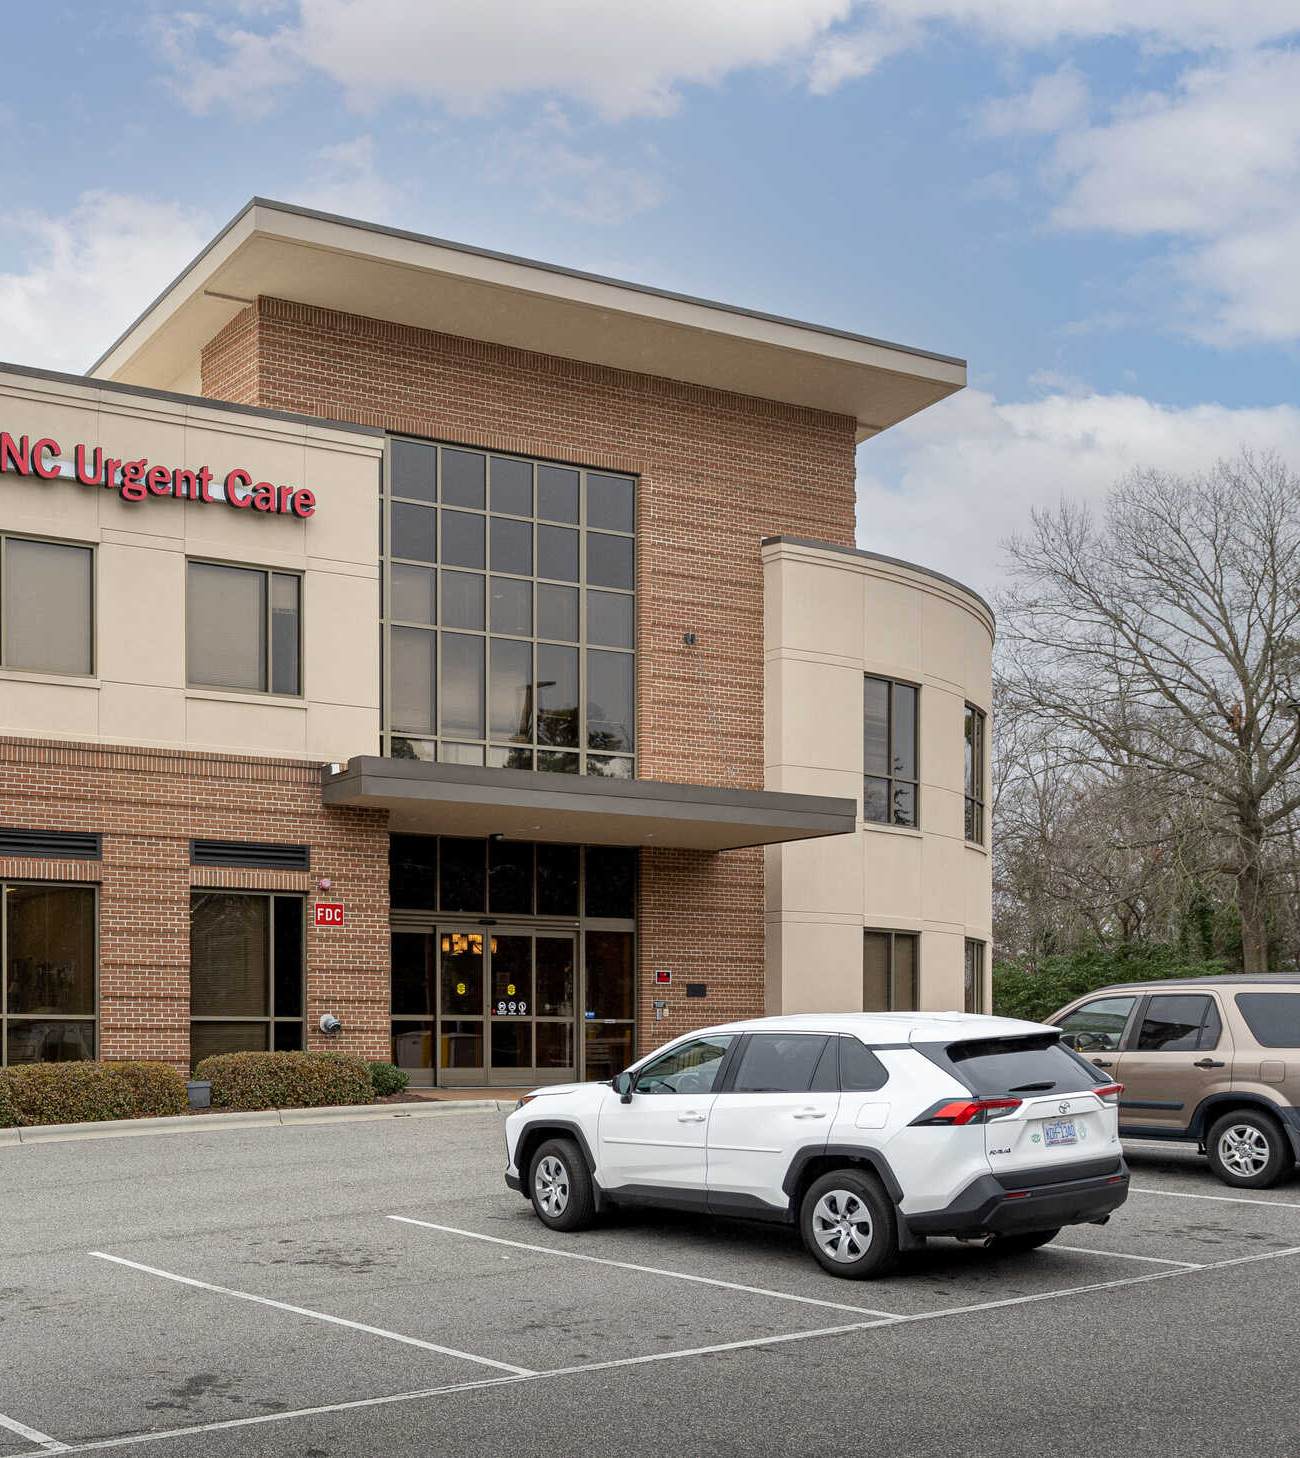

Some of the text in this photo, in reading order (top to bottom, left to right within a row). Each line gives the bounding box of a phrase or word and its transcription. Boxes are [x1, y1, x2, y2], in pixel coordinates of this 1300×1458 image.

[75, 444, 213, 501] Urgent
[224, 468, 316, 518] Care
[317, 908, 341, 921] FDC
